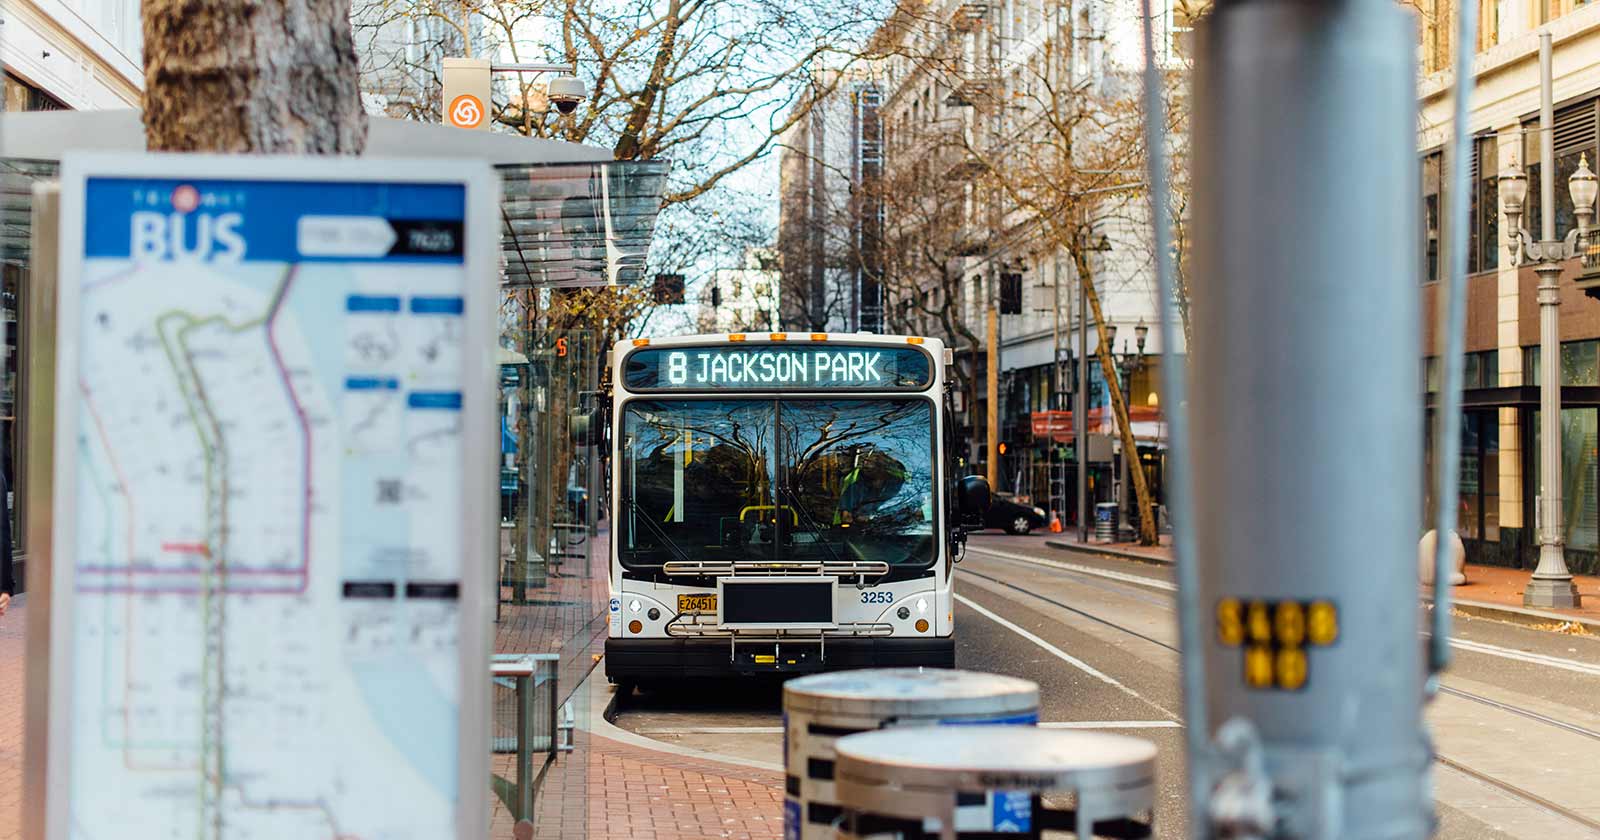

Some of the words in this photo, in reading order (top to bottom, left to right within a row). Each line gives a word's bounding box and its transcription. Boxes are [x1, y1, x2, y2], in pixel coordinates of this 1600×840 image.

[130, 210, 247, 263] BUS
[668, 351, 688, 385] 8
[696, 352, 808, 383] JACKSON
[814, 351, 882, 382] PARK
[860, 591, 894, 604] 3253
